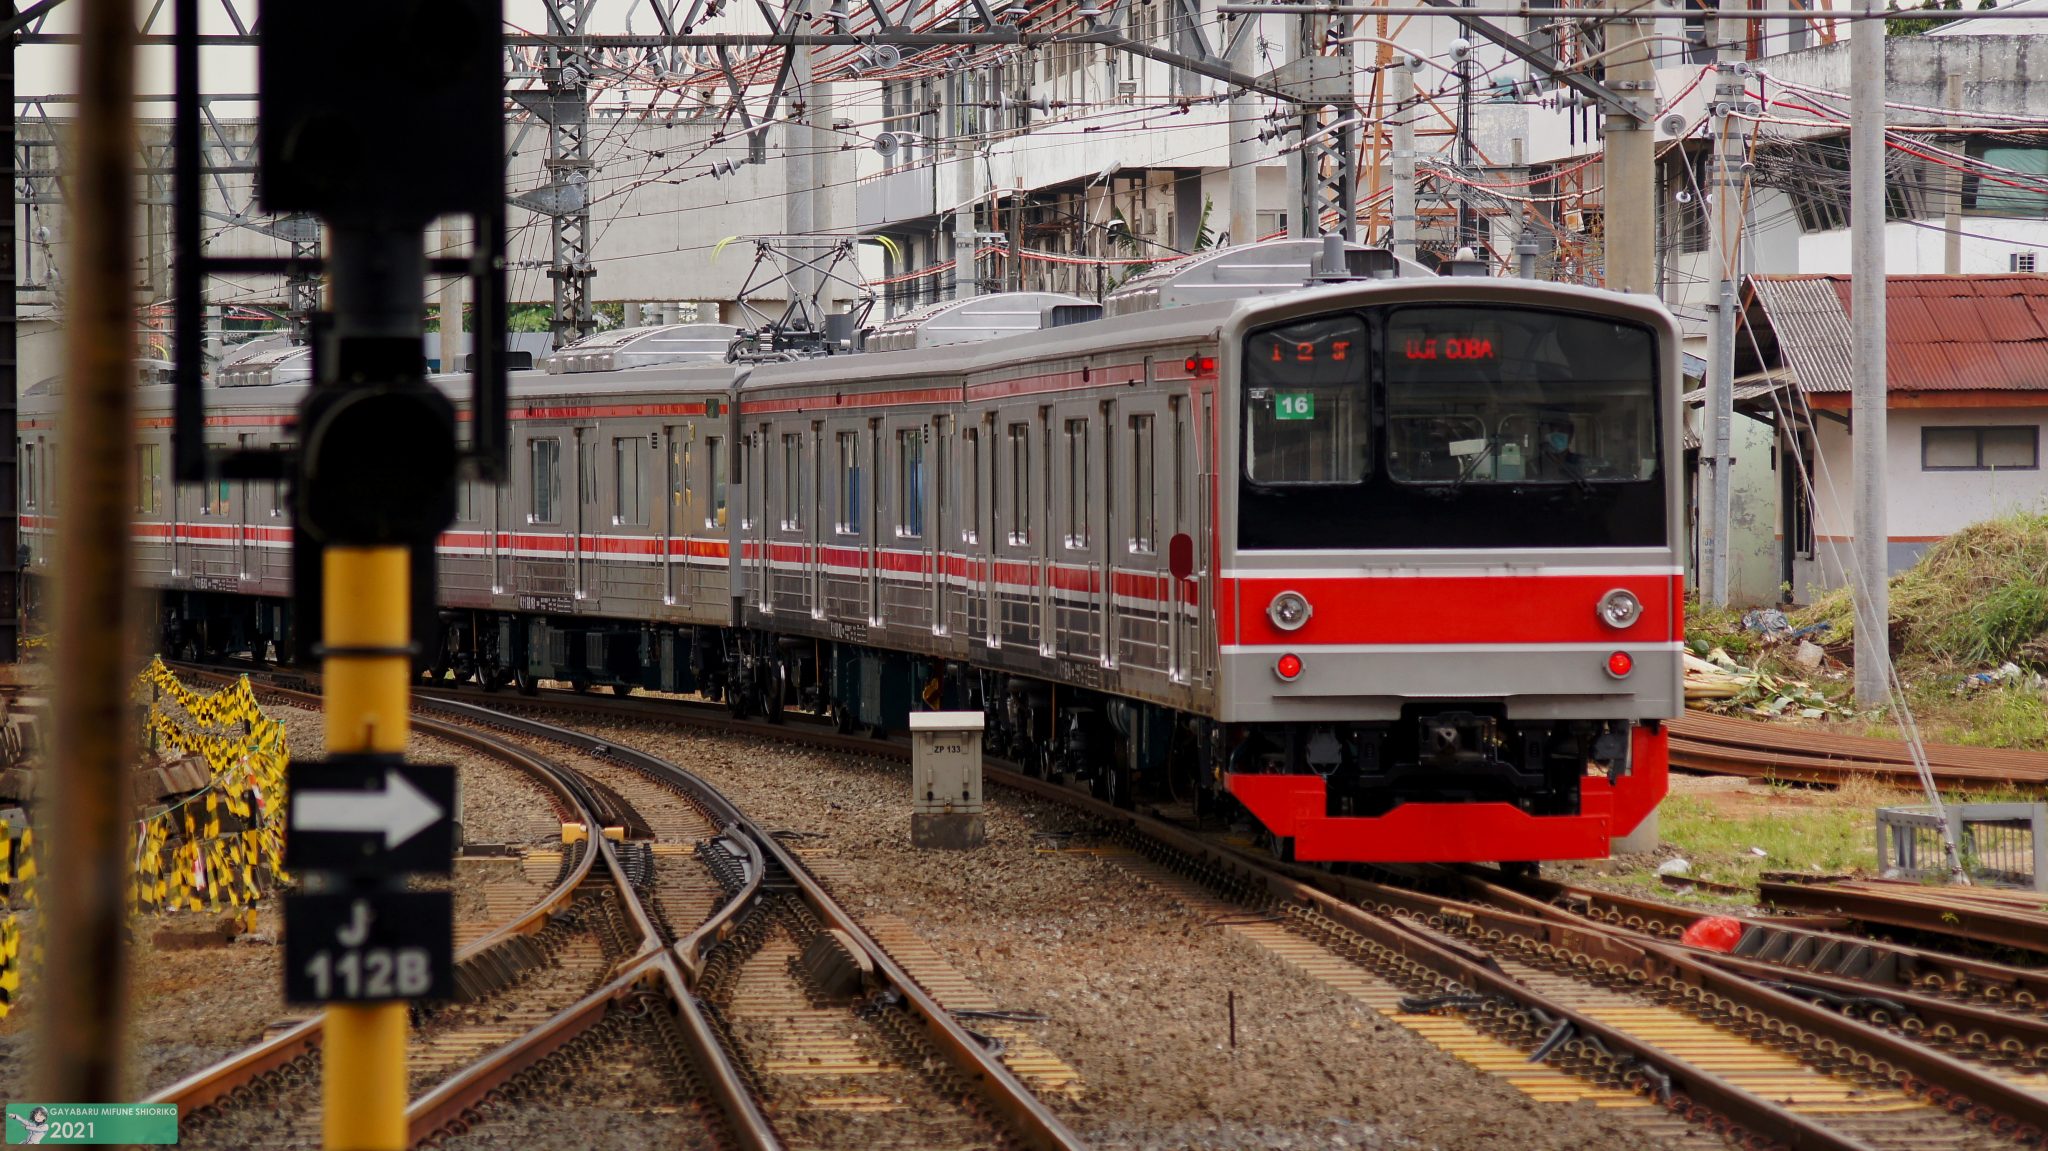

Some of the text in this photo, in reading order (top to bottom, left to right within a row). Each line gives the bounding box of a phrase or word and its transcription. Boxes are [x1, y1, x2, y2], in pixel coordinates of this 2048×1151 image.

[1282, 397, 1308, 414] 16
[934, 745, 961, 753] ZP 133
[336, 899, 370, 946] J
[305, 949, 432, 998] 112B
